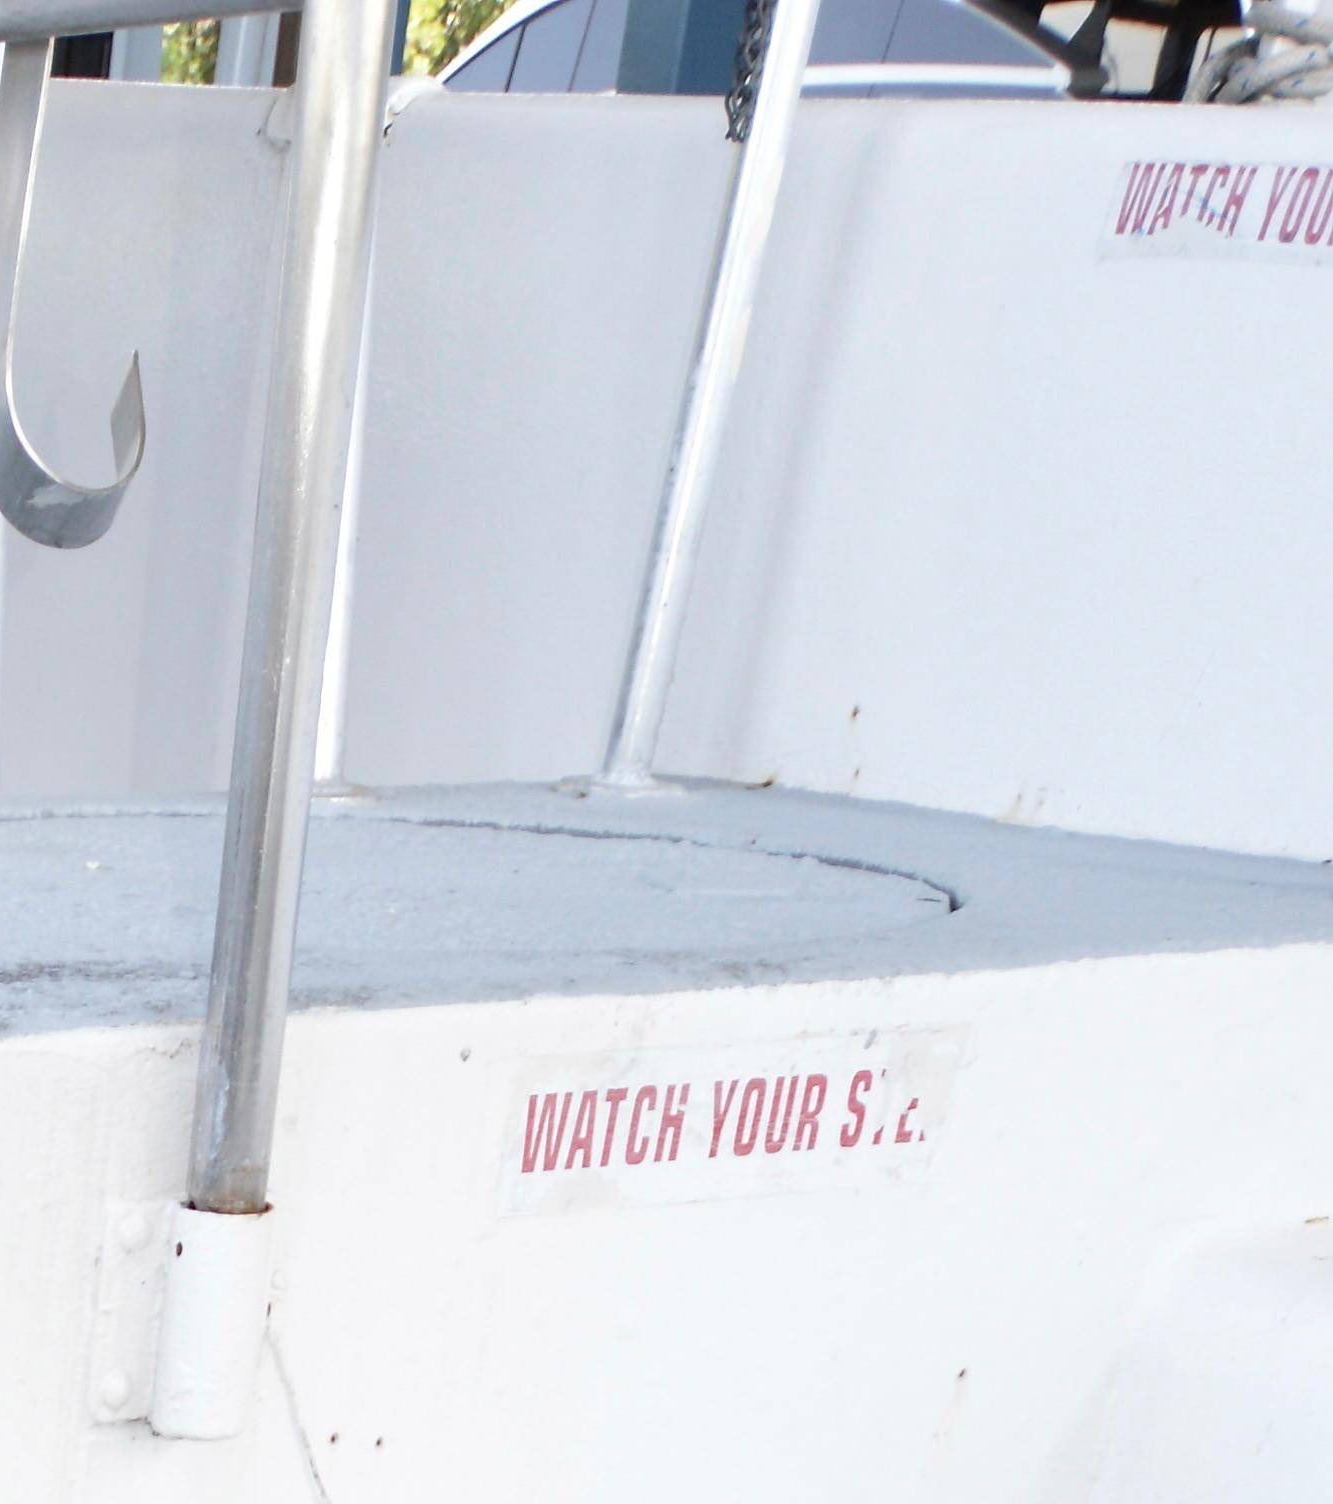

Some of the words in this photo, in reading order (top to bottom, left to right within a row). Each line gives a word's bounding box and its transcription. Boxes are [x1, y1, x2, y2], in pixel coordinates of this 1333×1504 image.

[1115, 162, 1259, 237] WATCH
[1257, 166, 1333, 247] YOU
[521, 1083, 691, 1173] WATCH
[708, 1072, 828, 1158] YOUR
